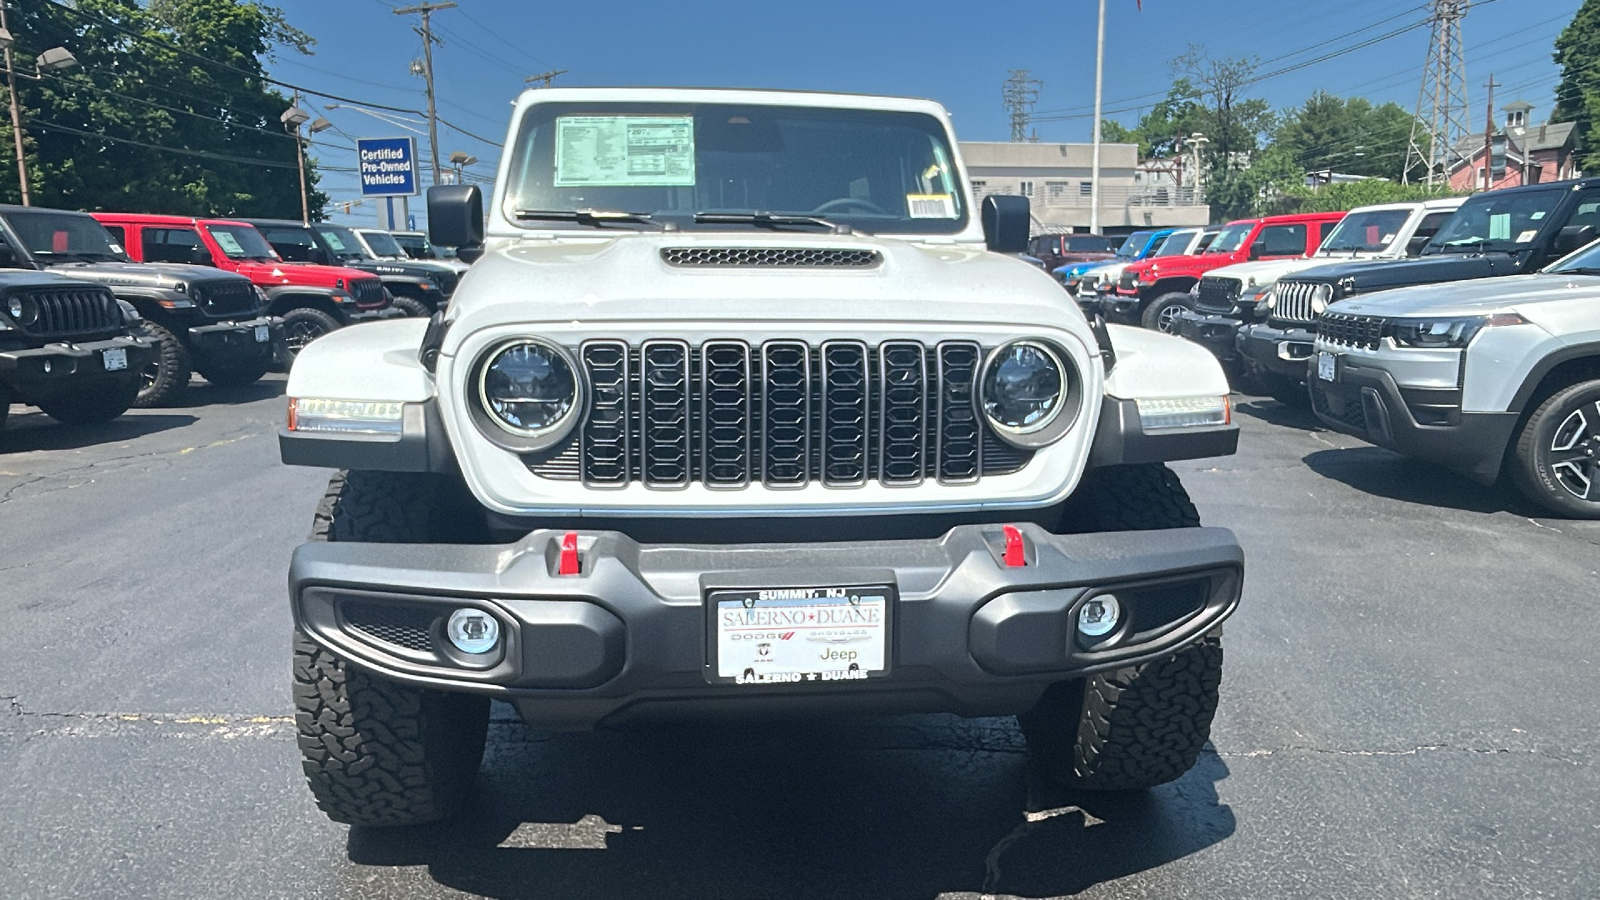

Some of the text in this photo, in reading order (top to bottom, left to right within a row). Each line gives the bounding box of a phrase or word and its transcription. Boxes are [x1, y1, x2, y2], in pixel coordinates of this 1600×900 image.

[361, 148, 404, 160] Certified
[362, 161, 411, 173] Pre-Owned
[363, 174, 405, 185] Vehicles
[826, 588, 846, 598] NJ
[723, 608, 879, 627] SALERNO DUANE
[731, 633, 786, 641] DODGE
[820, 647, 857, 662] Jeep
[735, 670, 868, 684] SALERNO DUANE
